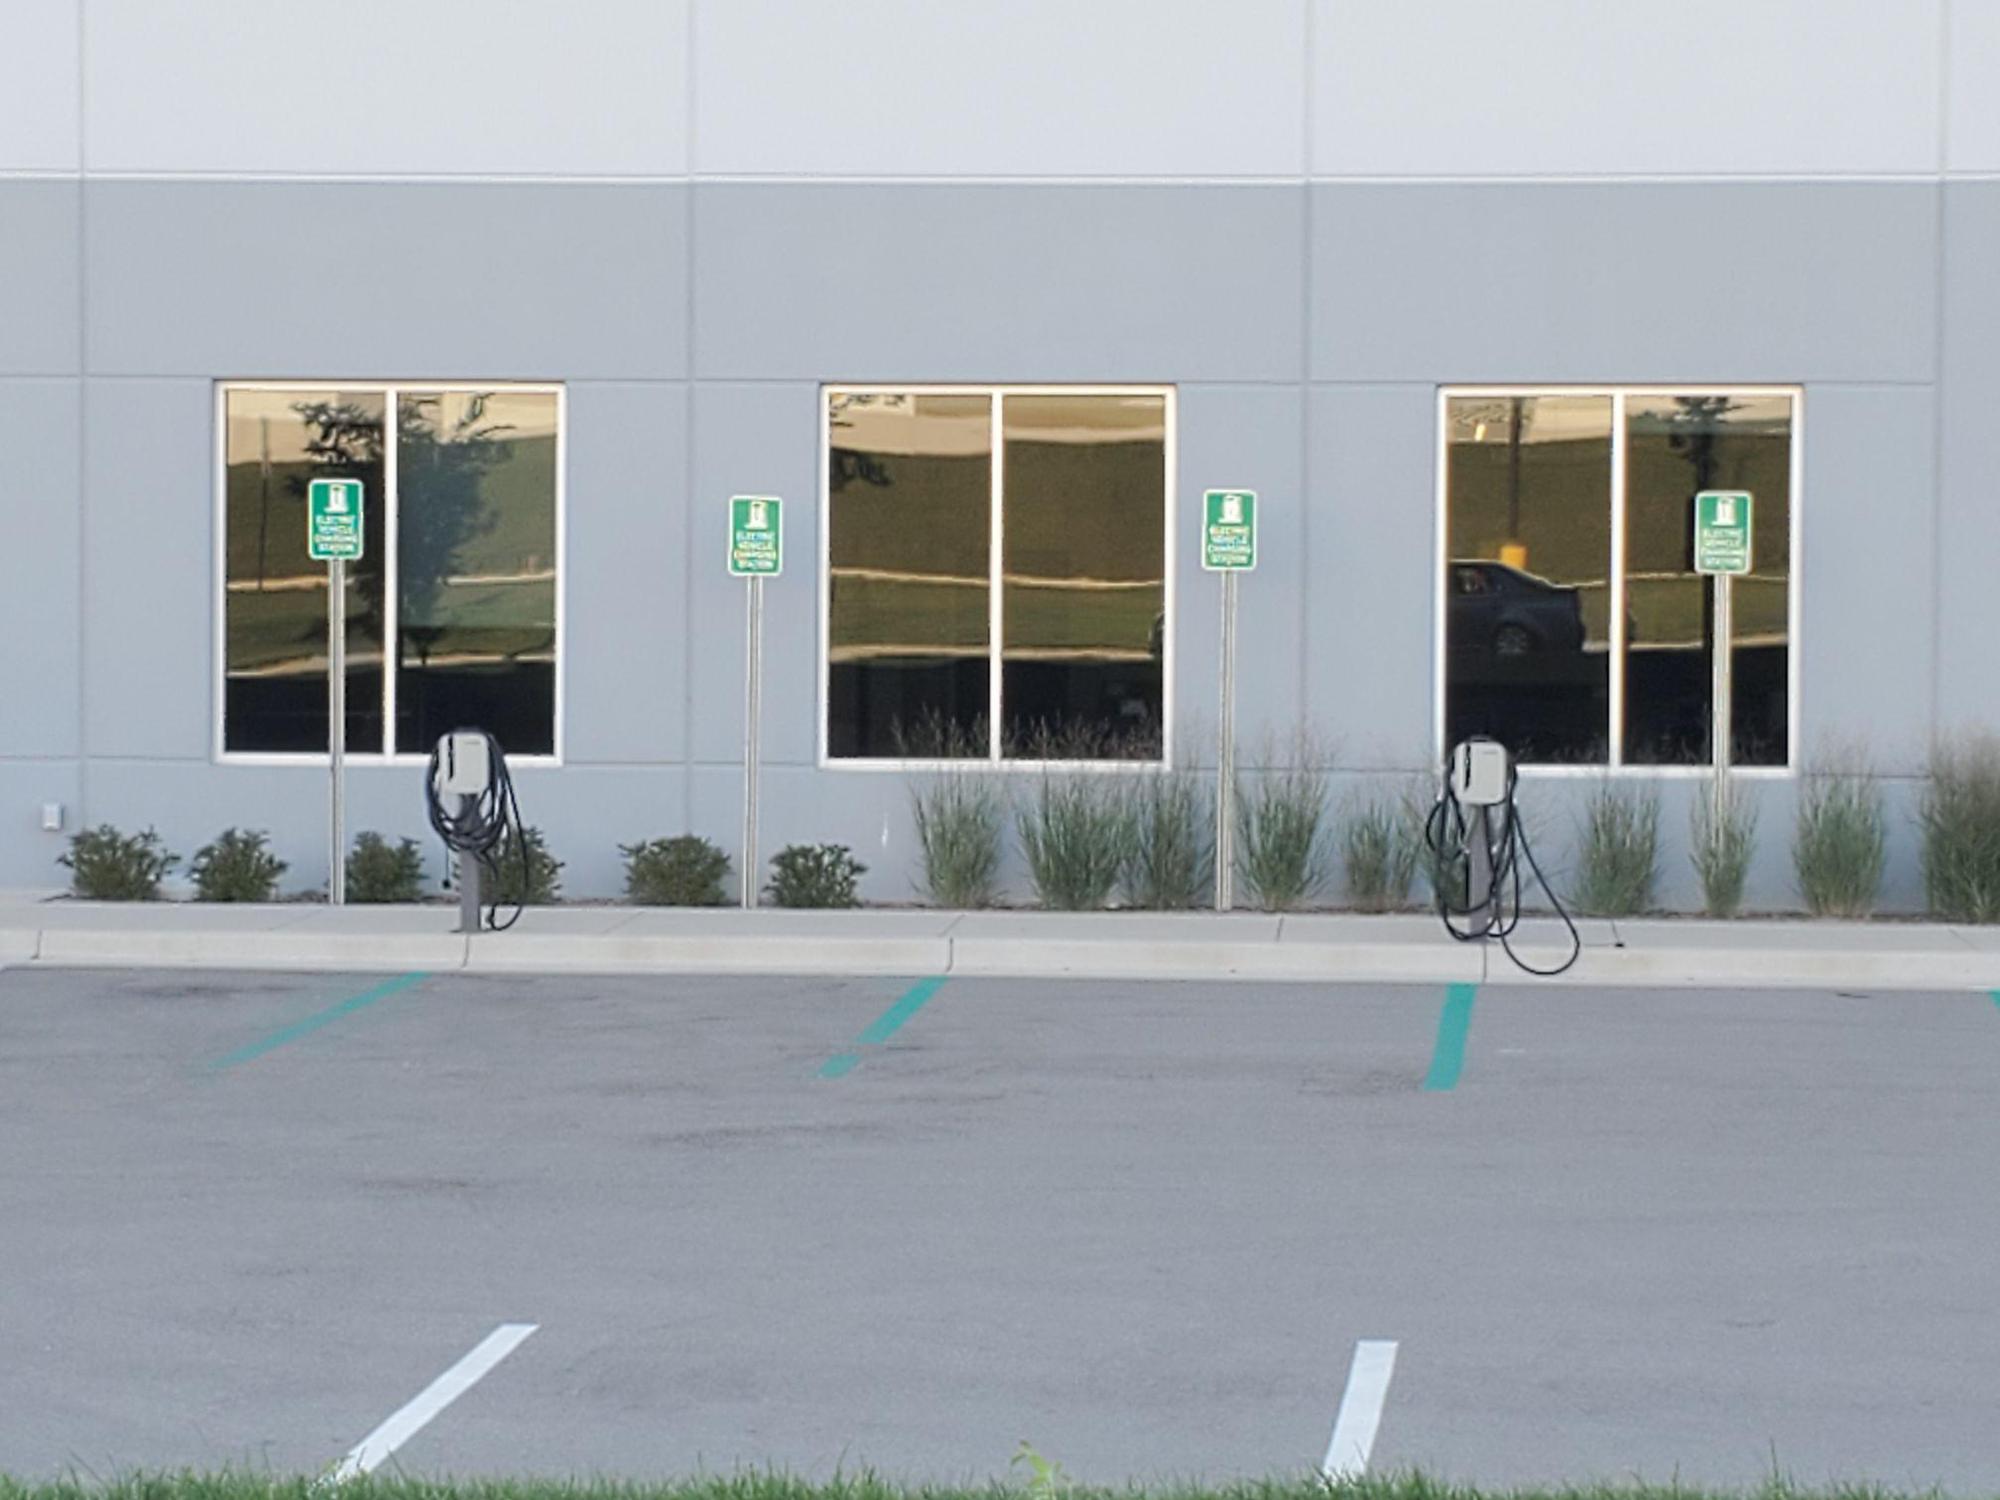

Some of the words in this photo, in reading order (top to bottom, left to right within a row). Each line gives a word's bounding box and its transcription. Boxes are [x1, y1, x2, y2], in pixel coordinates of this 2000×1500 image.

[315, 515, 355, 525] ELECTRIC
[318, 525, 354, 535] VEHICLE
[1209, 526, 1249, 536] ELECTRIC
[1703, 528, 1743, 538] ELECTRIC
[736, 531, 775, 541] ELECTRIC
[738, 541, 774, 550] VEHICLE
